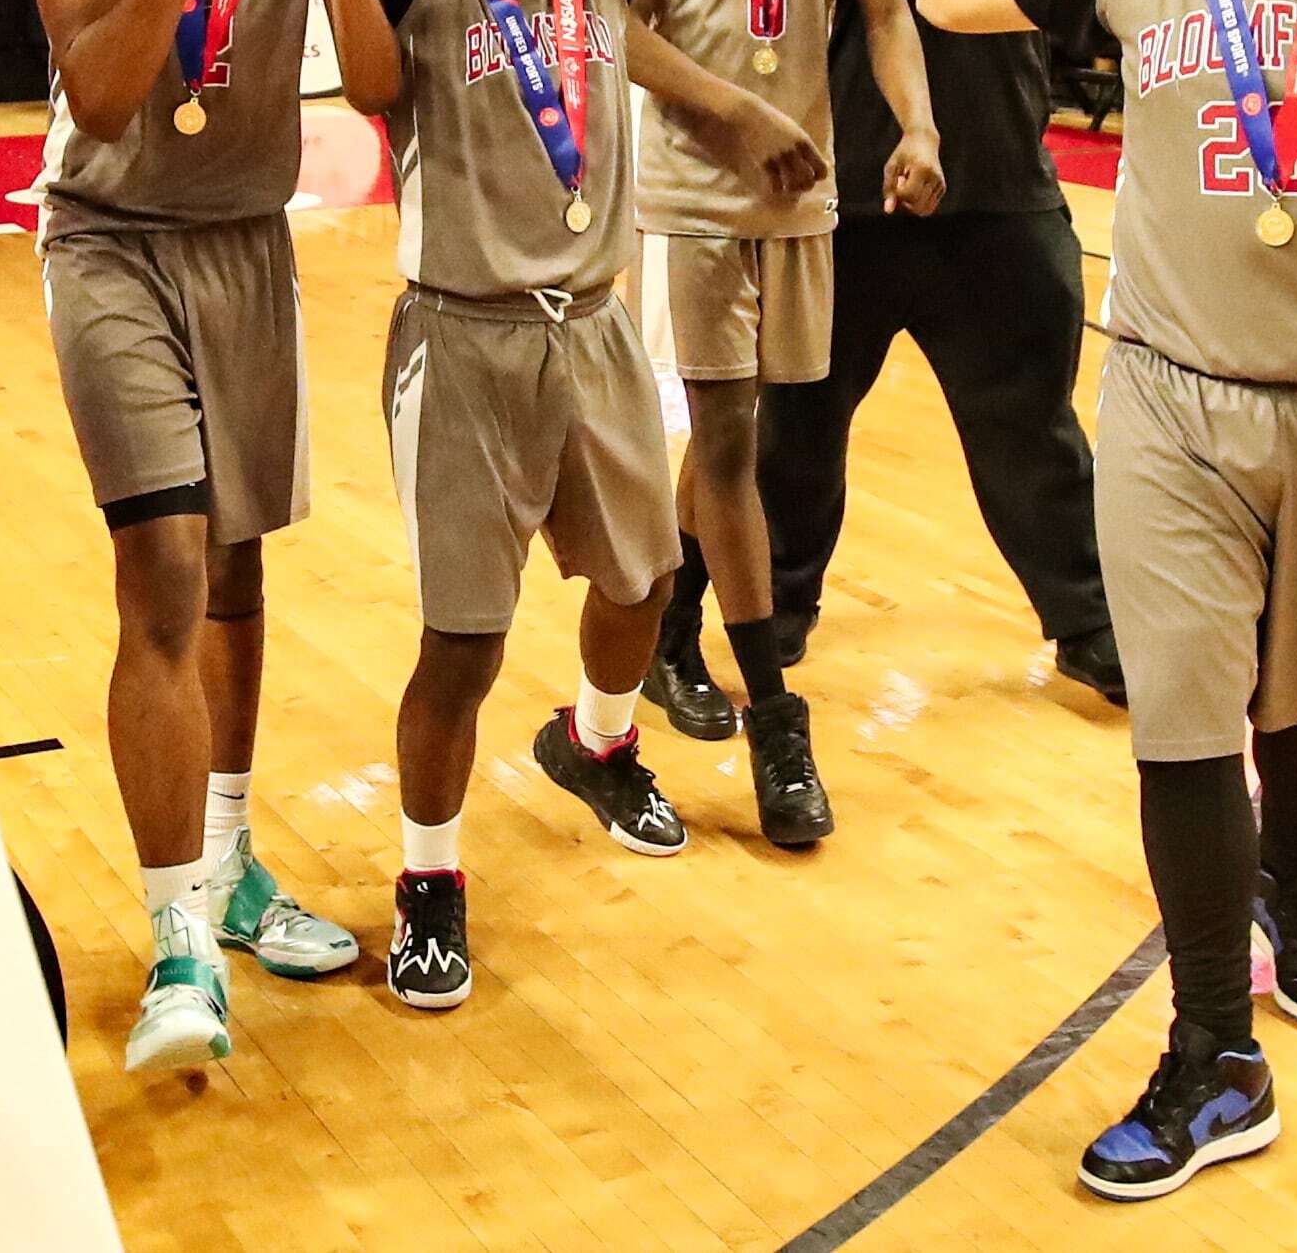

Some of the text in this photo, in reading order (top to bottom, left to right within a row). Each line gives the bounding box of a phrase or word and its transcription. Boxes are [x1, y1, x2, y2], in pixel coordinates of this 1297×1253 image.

[506, 16, 544, 91] UNIFIED SPORTS
[1226, 30, 1247, 74] SPORTS
